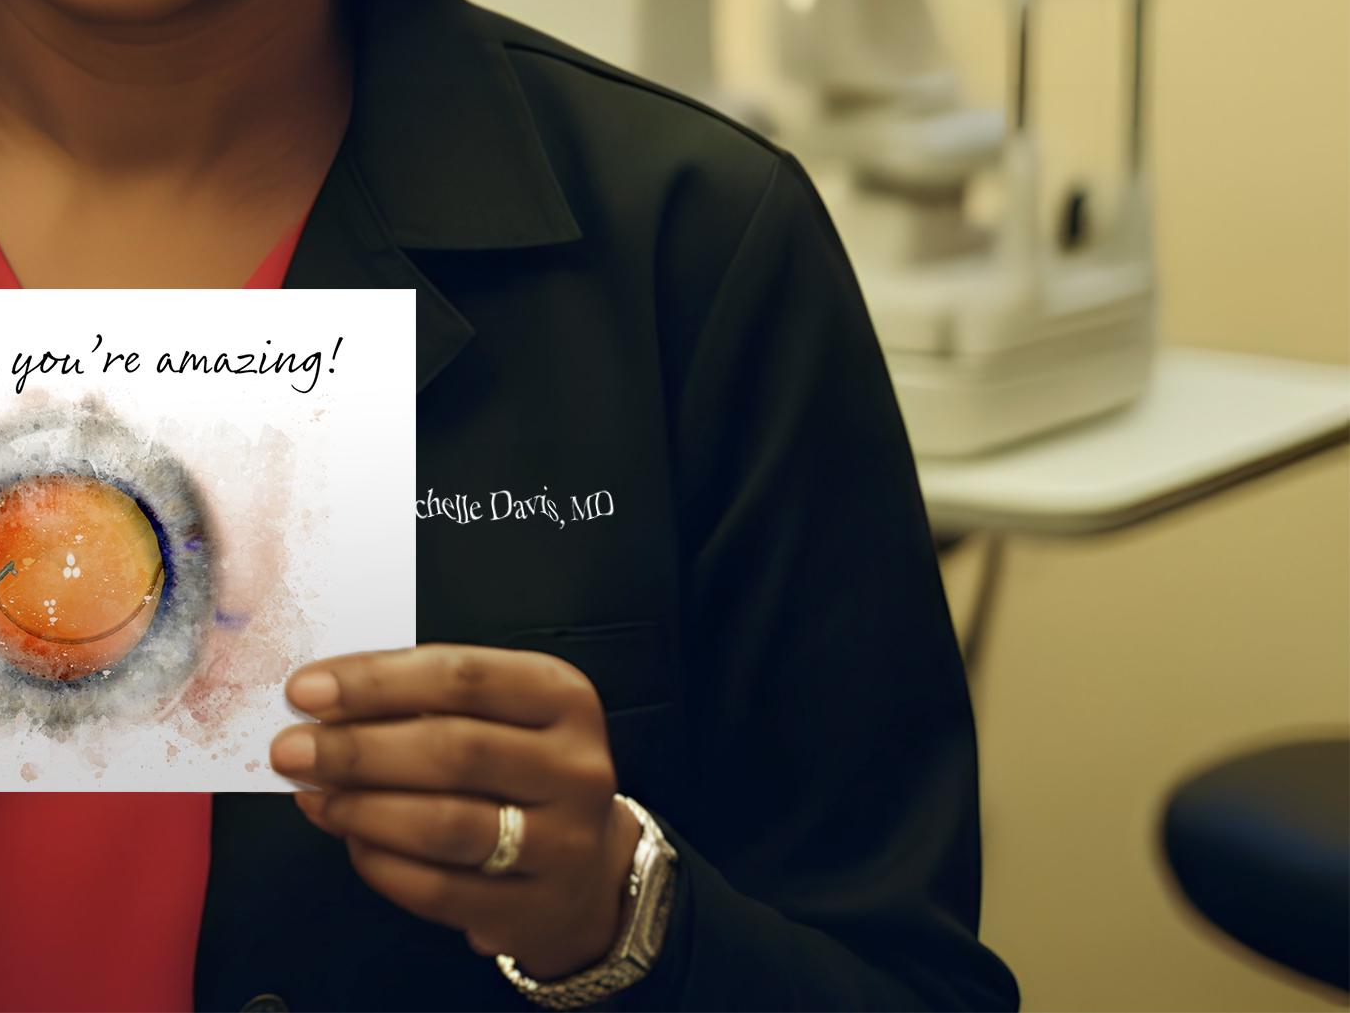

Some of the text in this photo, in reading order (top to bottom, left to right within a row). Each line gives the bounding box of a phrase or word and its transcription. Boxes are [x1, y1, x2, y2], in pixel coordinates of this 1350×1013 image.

[11, 333, 142, 395] you’re
[156, 336, 345, 394] amazing!
[416, 485, 615, 530] chelle Davis, MD
